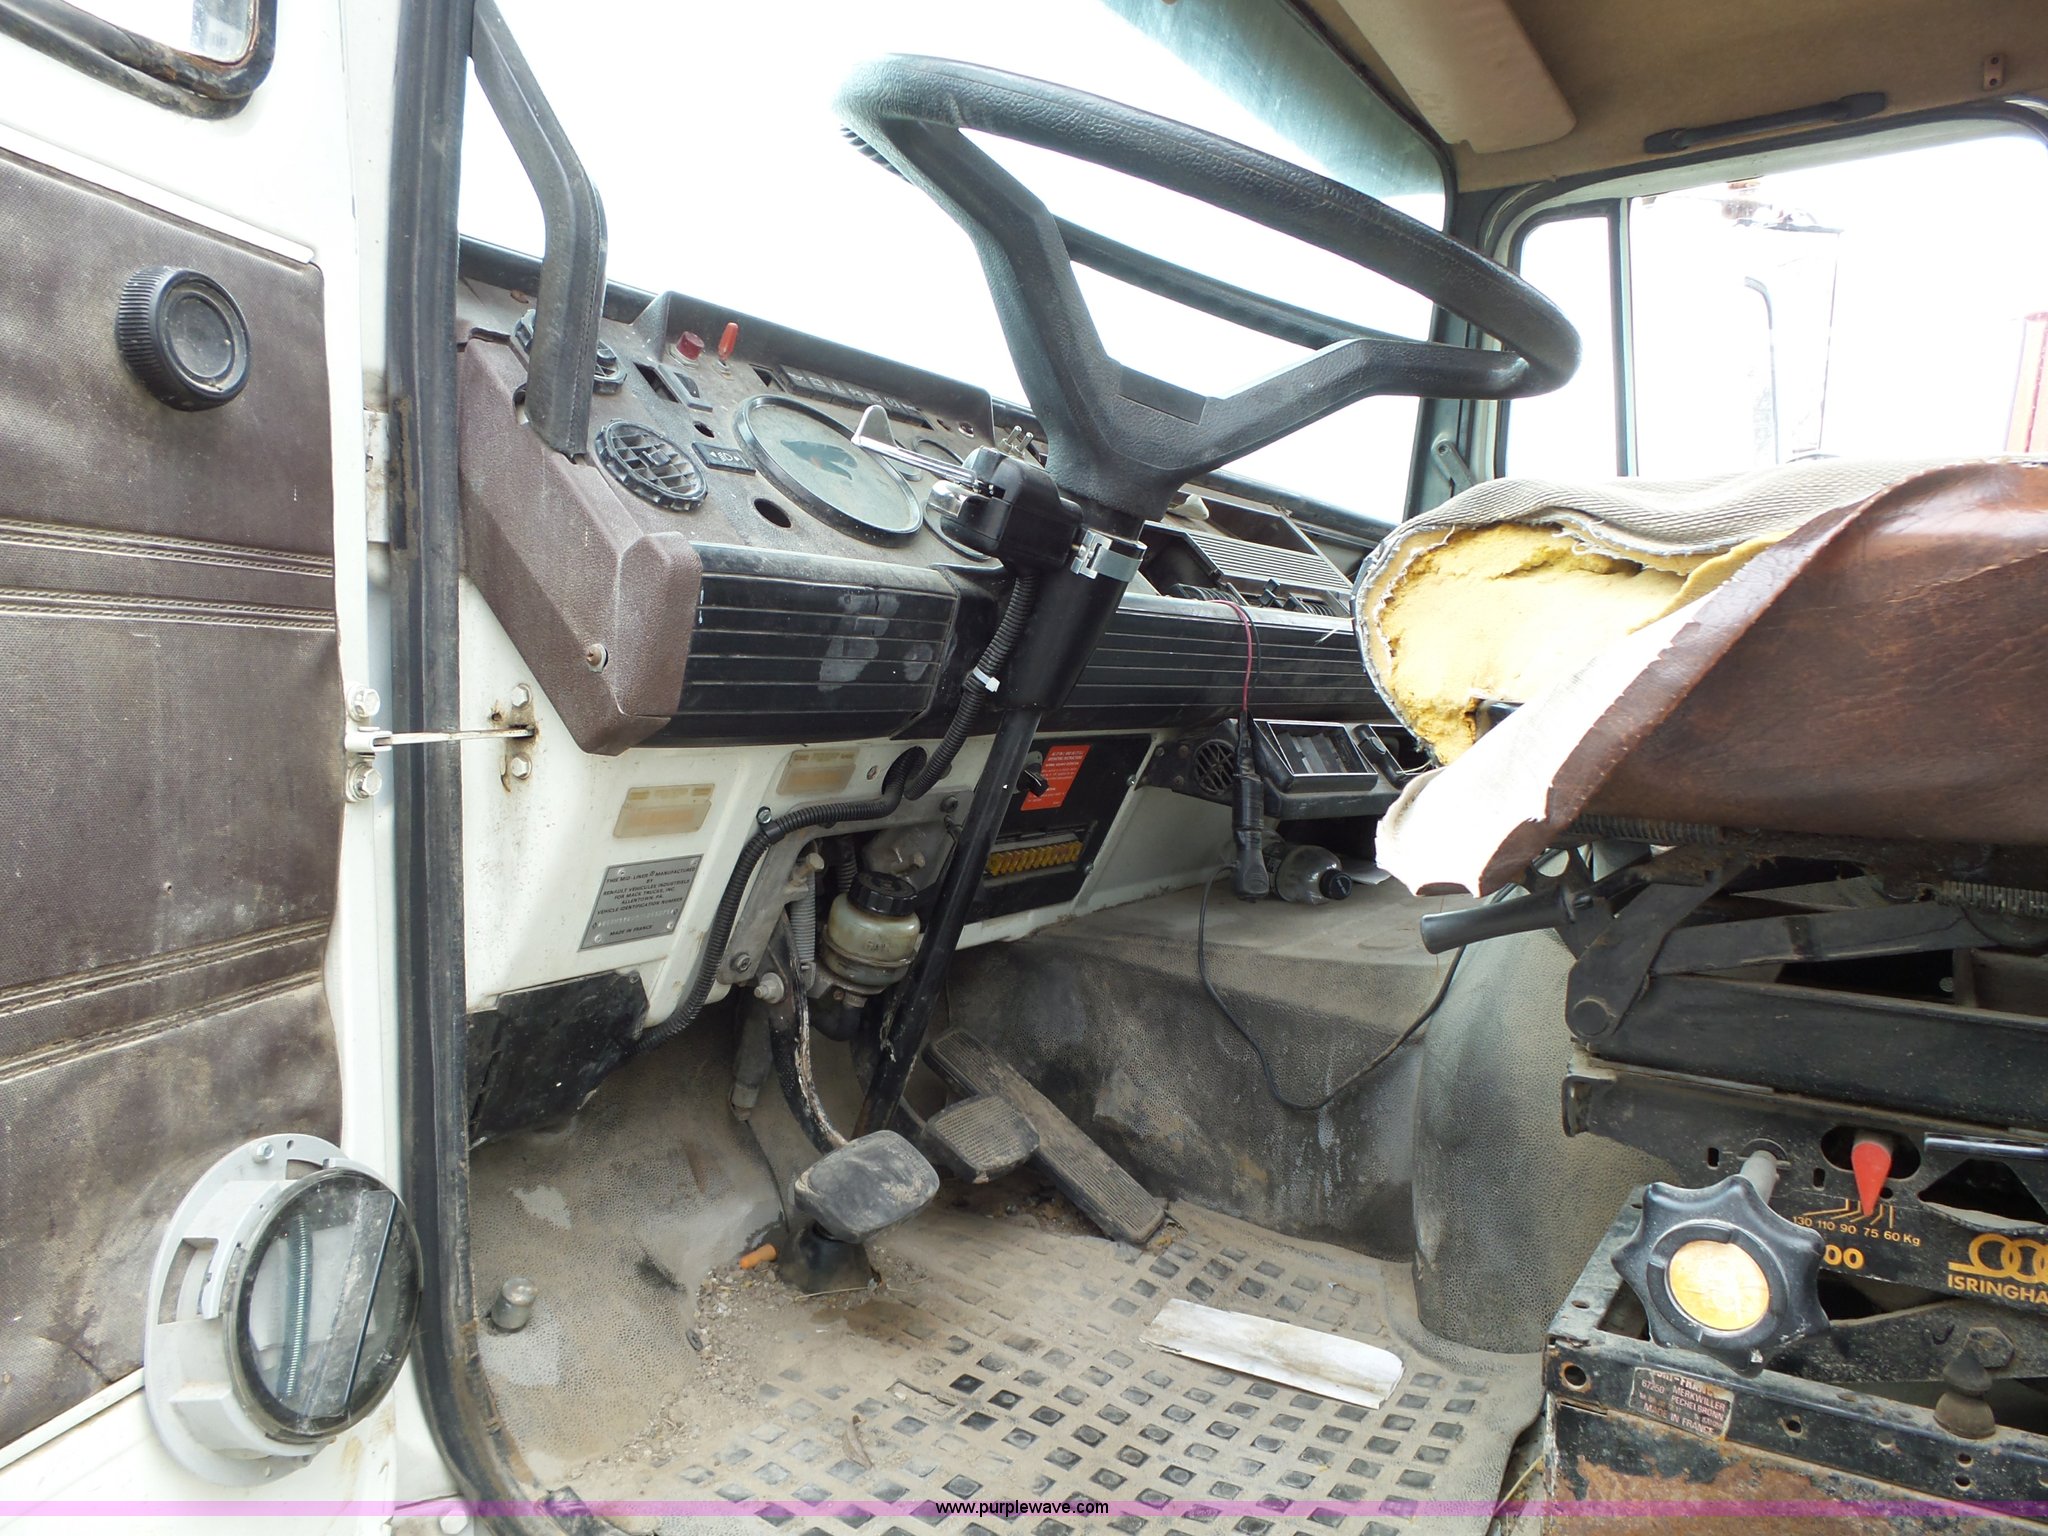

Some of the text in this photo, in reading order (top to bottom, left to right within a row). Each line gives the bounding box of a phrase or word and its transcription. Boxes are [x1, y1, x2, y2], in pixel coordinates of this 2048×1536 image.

[655, 867, 696, 877] MANUFACTURED
[603, 887, 628, 896] RENAULT
[621, 896, 654, 905] ALLENTOWN
[597, 897, 683, 916] VEHICLE IDENTIFICATION NUMBER
[633, 924, 653, 932] FRANCE
[1792, 1216, 1920, 1247] 130 110 90 75 60 Kg
[1671, 1394, 1724, 1421] PECHELBRONN
[1672, 1385, 1726, 1412] MERKWILLER
[1643, 1402, 1668, 1419] MADE
[1670, 1412, 1680, 1423] IN
[1681, 1418, 1715, 1436] FRANCE
